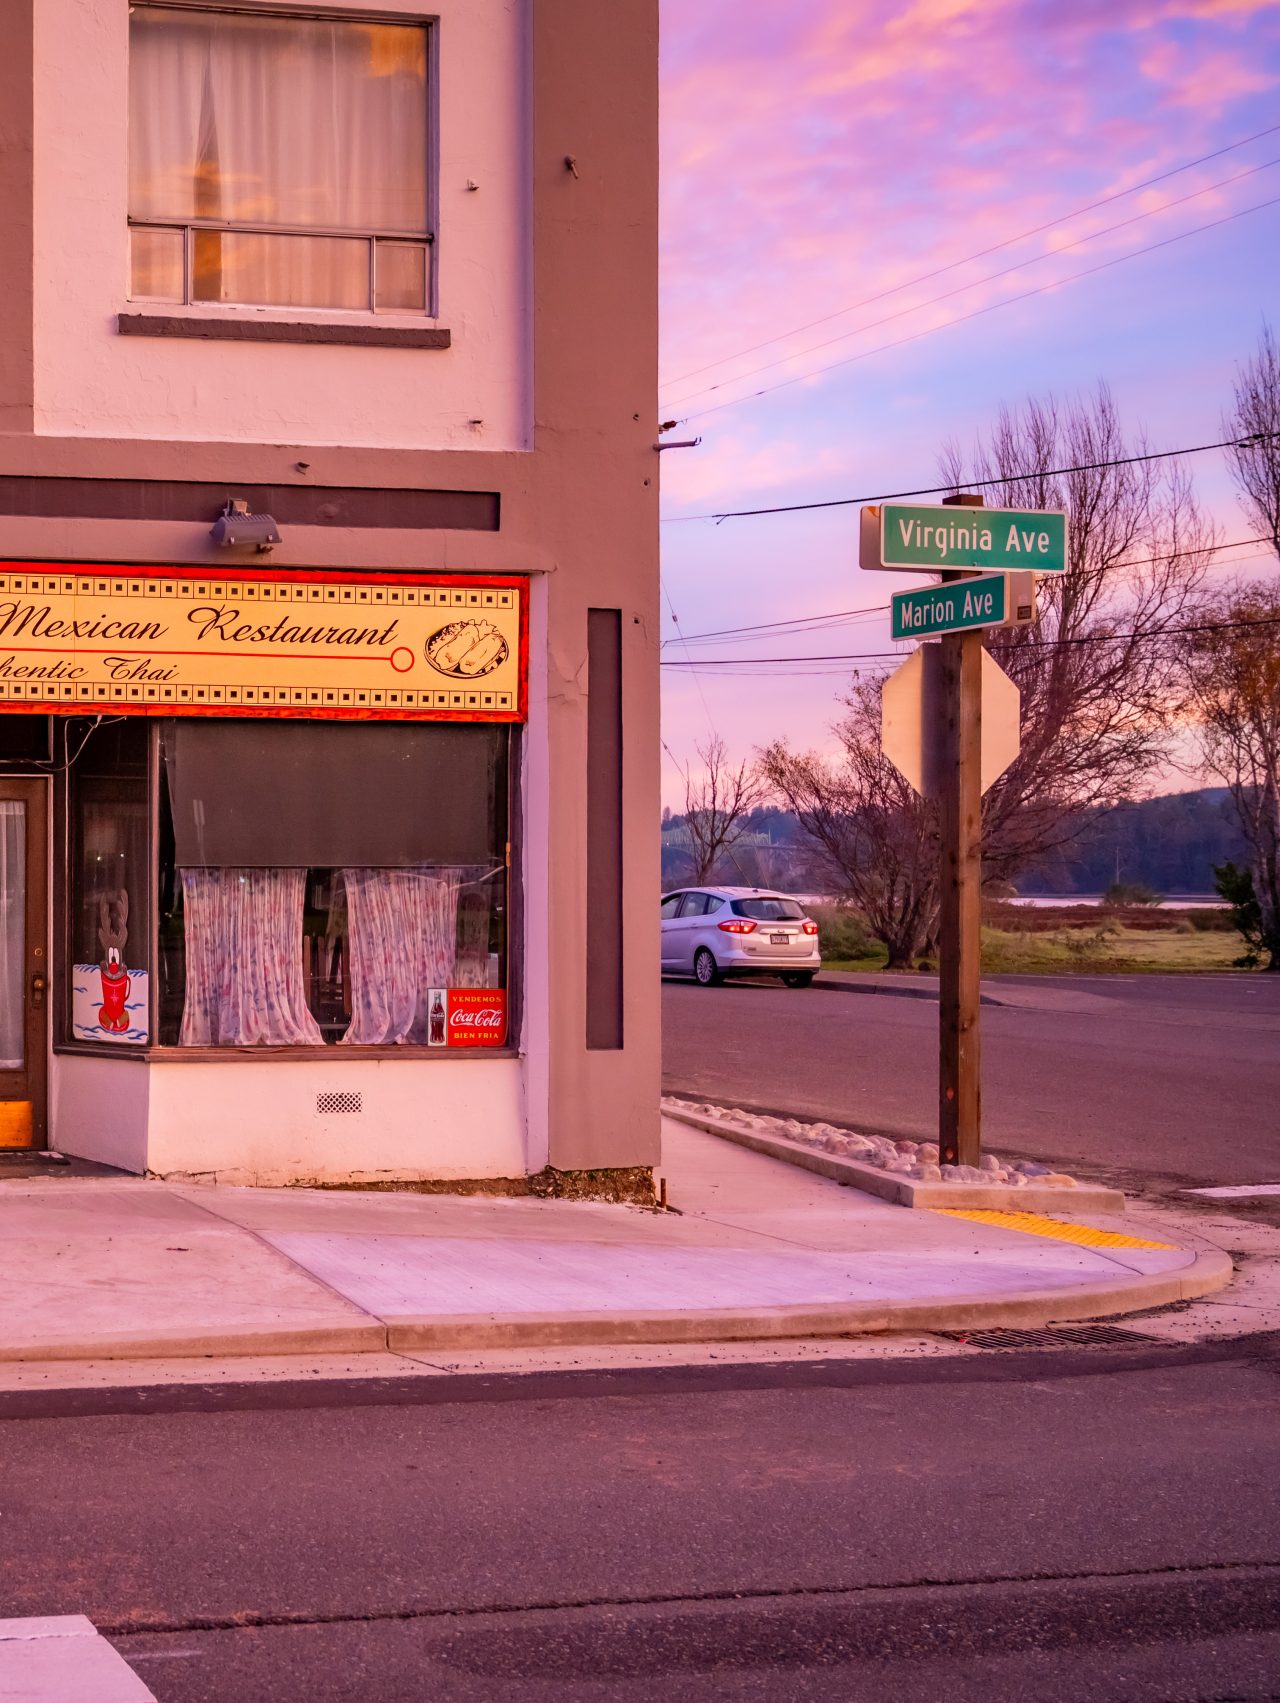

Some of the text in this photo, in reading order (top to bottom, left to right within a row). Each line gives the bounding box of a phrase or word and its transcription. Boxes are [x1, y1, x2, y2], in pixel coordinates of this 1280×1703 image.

[898, 519, 1050, 558] Virginia Ave
[187, 603, 400, 647] Restaurant
[901, 597, 954, 629] Marion
[963, 590, 993, 619] Ave
[104, 656, 181, 682] Thai
[450, 1008, 503, 1027] Coca-Cola
